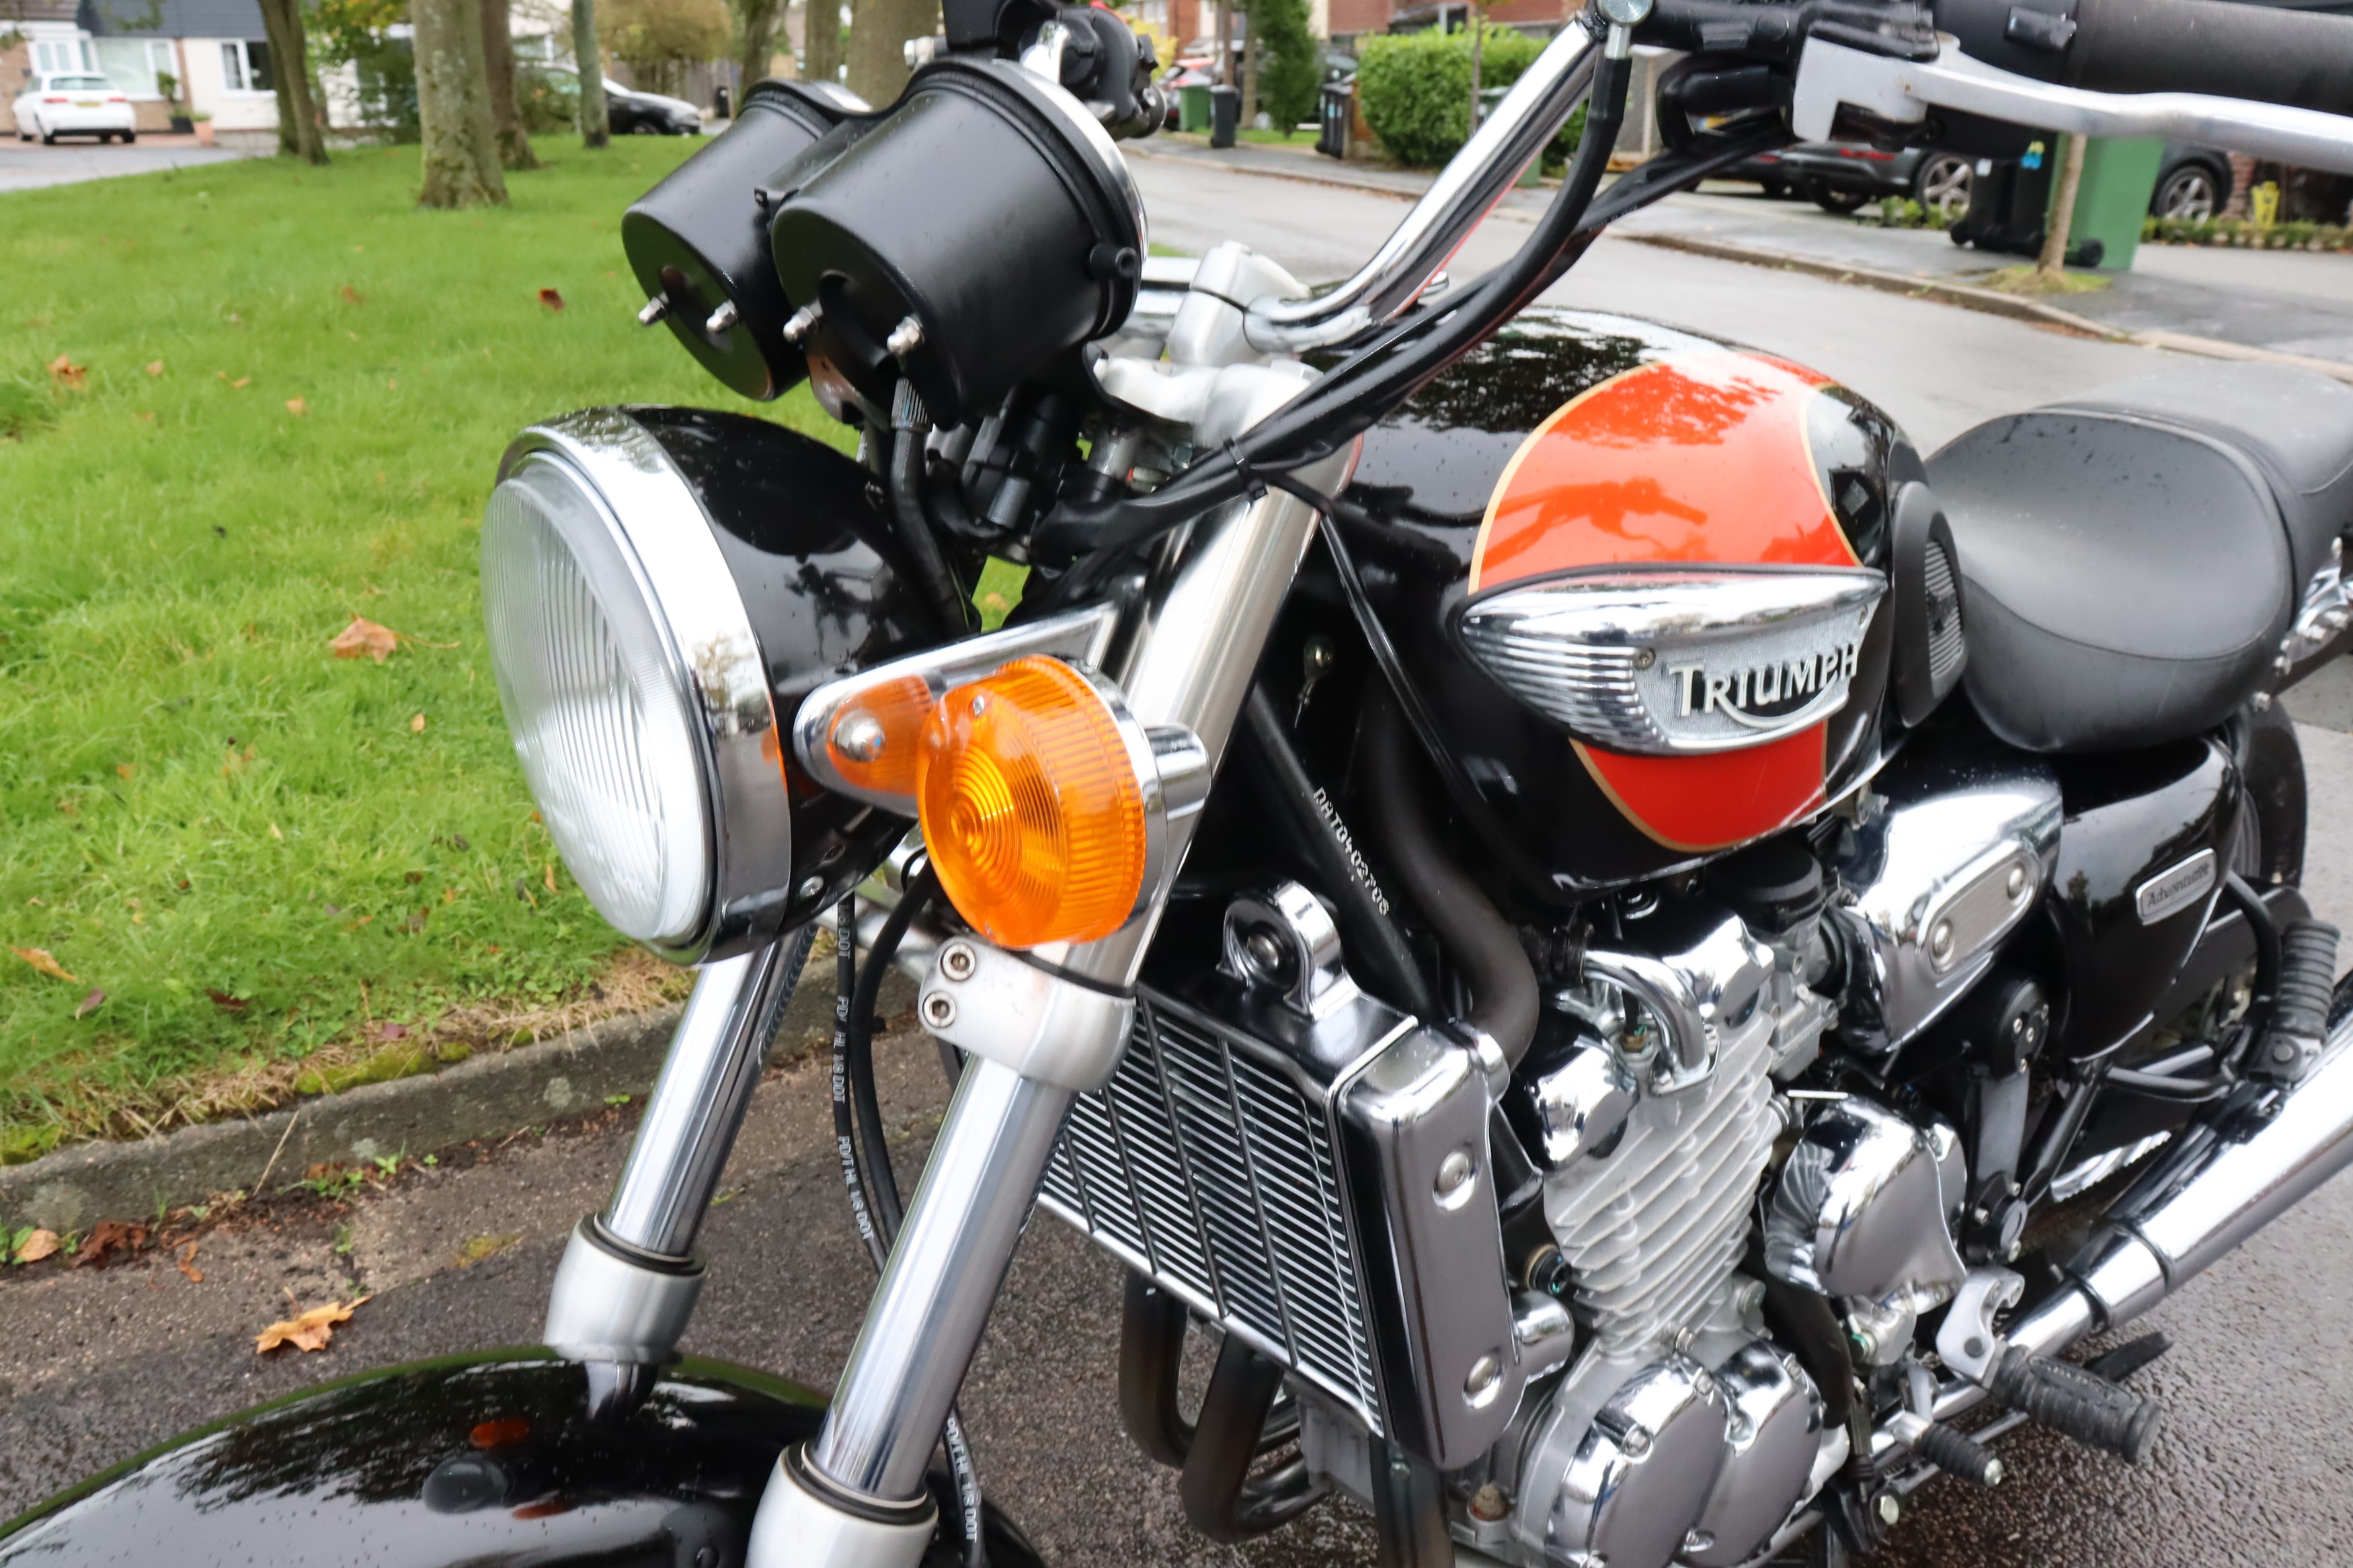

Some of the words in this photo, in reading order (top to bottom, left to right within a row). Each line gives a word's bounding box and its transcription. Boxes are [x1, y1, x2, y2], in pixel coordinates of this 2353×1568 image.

[1667, 641, 1861, 728] TRIUMPH
[838, 927, 850, 959] DOT
[837, 995, 849, 1023] PD/
[832, 1075, 845, 1104] DOT
[856, 1210, 875, 1240] DOT
[964, 1508, 978, 1544] DOT
